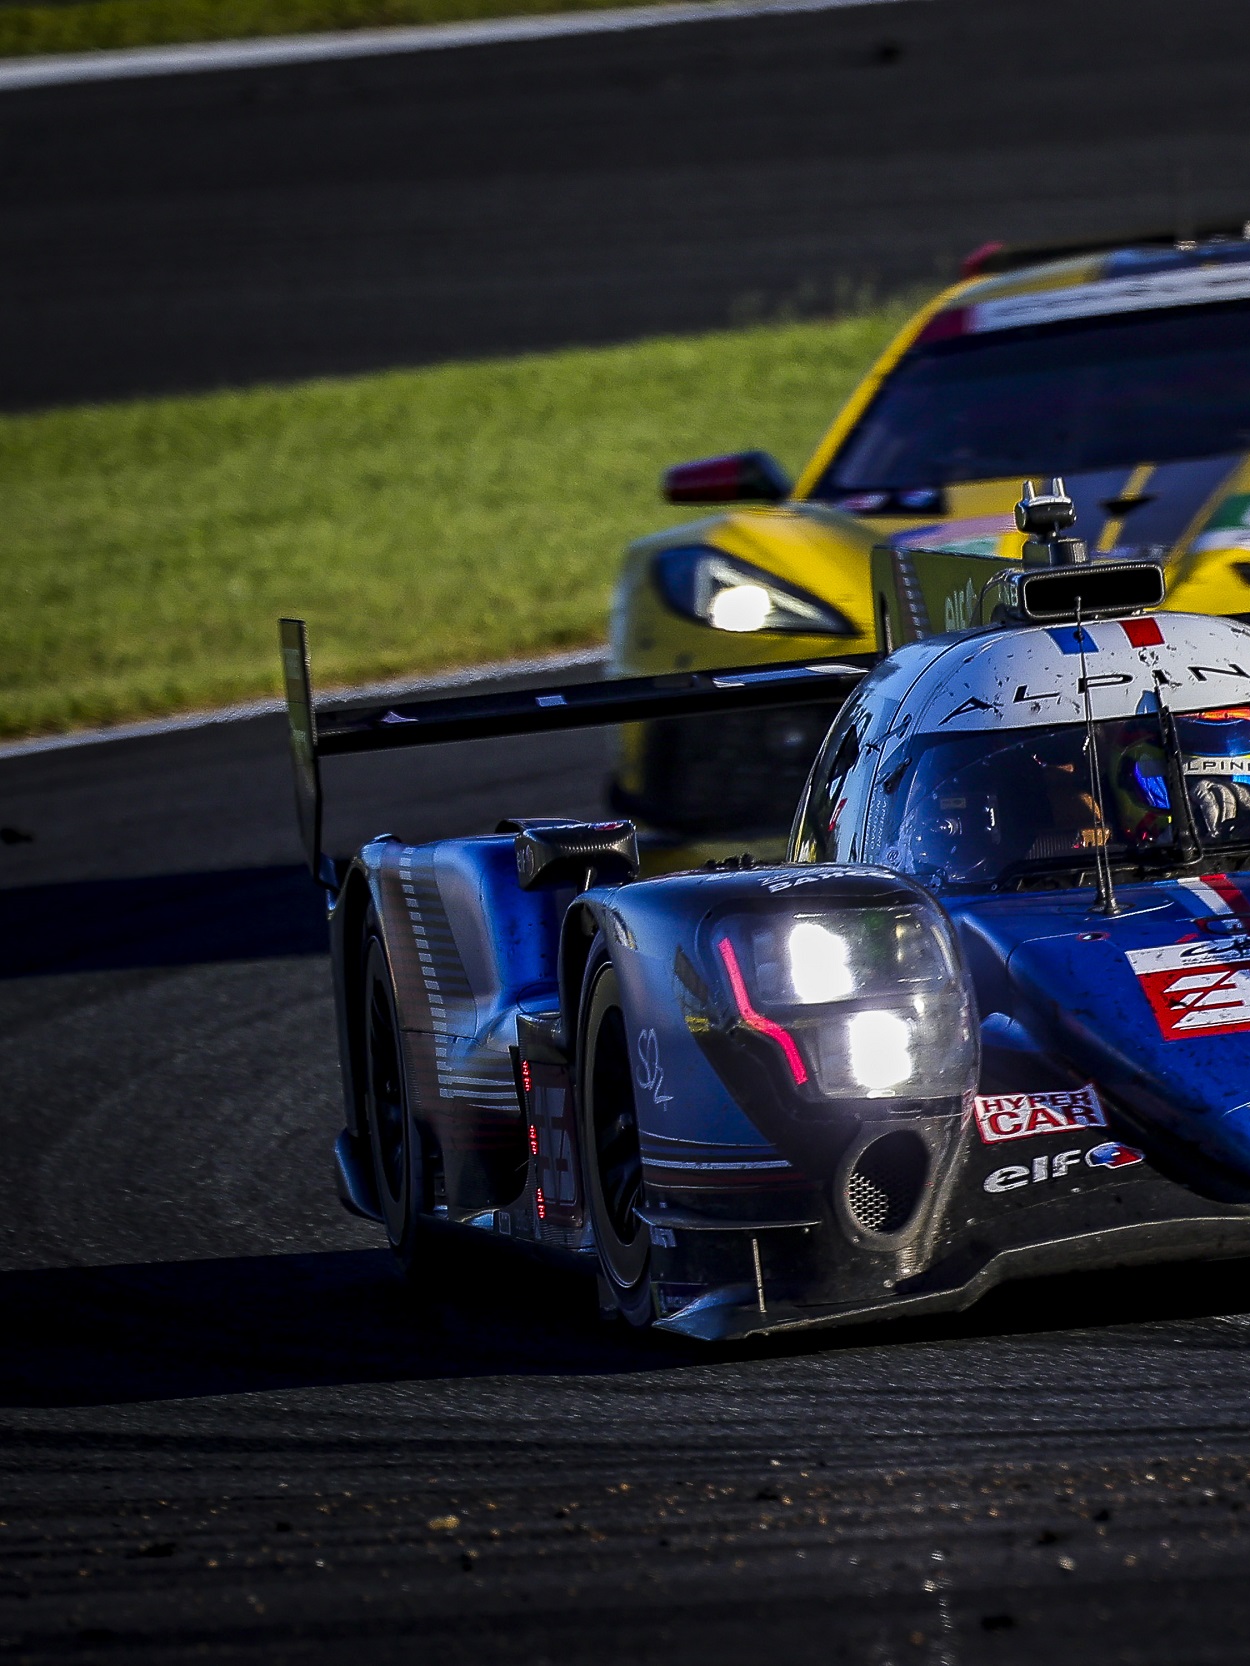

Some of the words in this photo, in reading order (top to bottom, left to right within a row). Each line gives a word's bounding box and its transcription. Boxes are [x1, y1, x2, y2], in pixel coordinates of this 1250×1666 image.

[982, 1089, 1093, 1114] HYPER
[988, 1103, 1100, 1136] CAR
[982, 1149, 1082, 1194] elf
